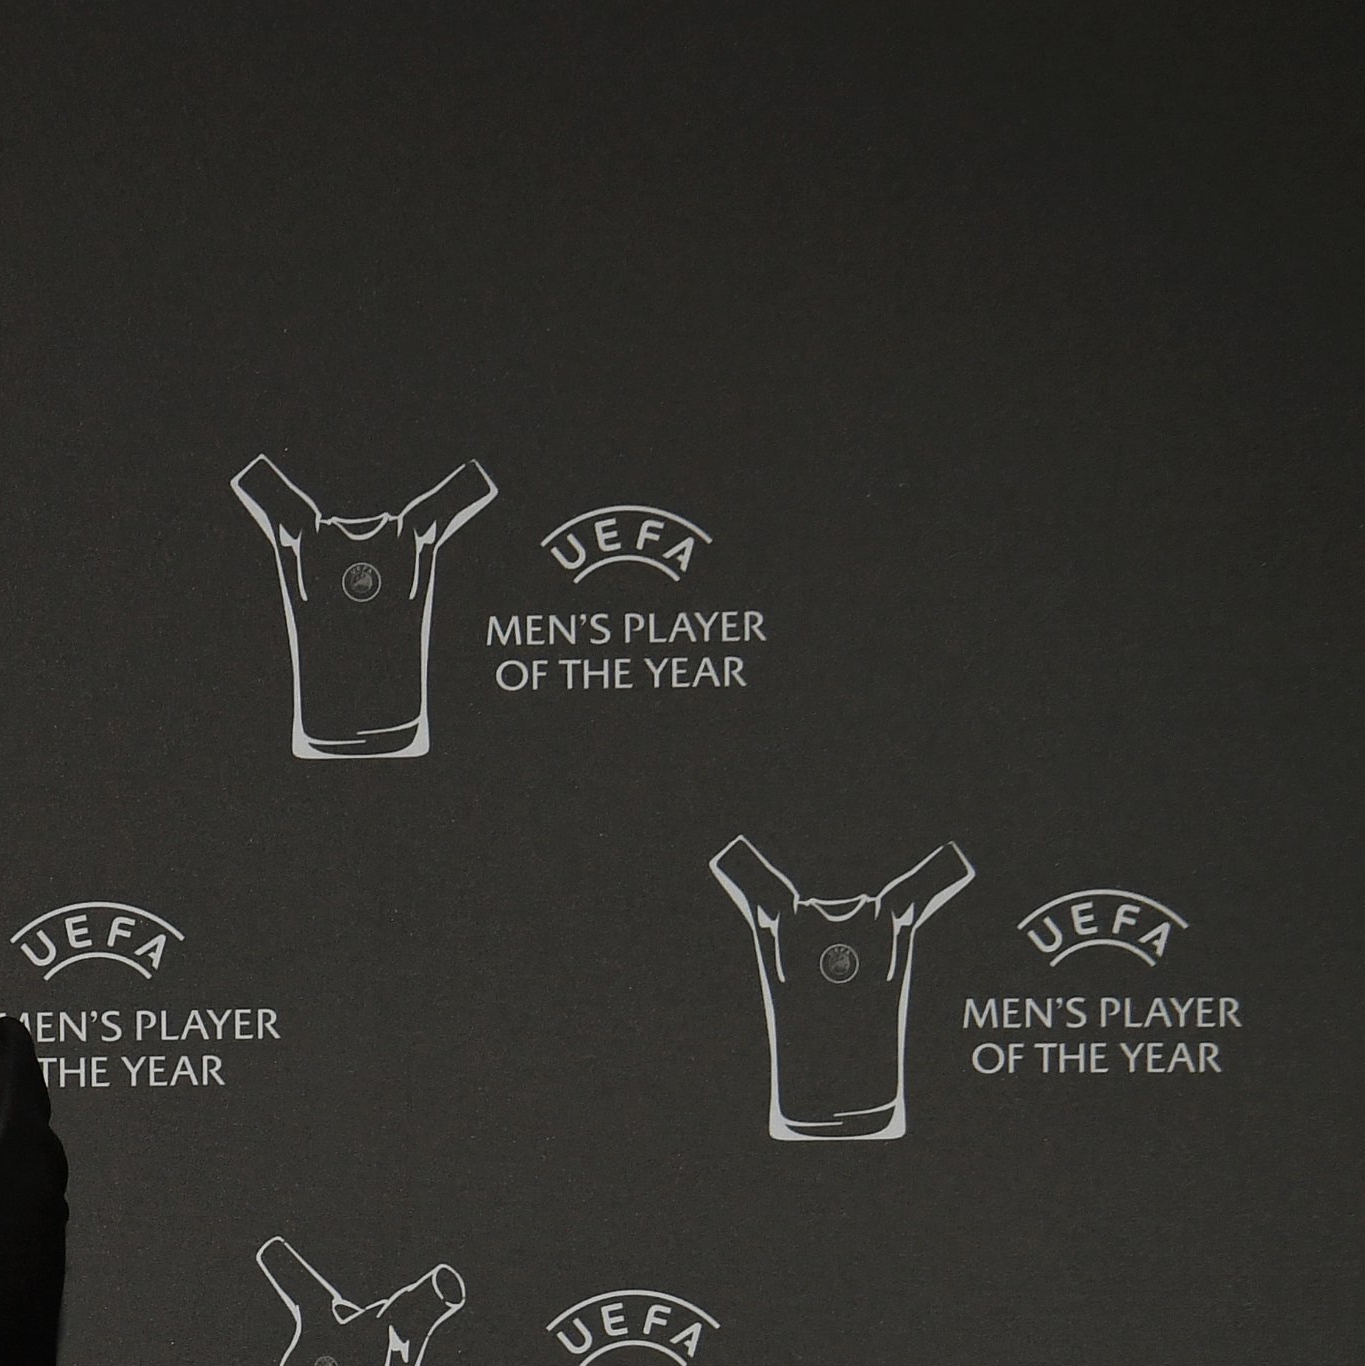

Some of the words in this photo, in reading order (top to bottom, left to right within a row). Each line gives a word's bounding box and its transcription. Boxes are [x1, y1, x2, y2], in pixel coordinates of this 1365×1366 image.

[551, 518, 694, 571] UEFA
[487, 614, 610, 645] MEN'S
[625, 611, 766, 643] PLAYER
[496, 660, 548, 691] OF
[559, 659, 633, 689] THE
[644, 657, 746, 688] YEAR
[21, 915, 167, 970] UEFA
[1028, 902, 1170, 956] UEFA
[136, 1009, 281, 1041] PLAYER
[963, 997, 1086, 1028] MEN'S
[1101, 998, 1241, 1027] PLAYER
[37, 1057, 111, 1088] THE
[121, 1055, 226, 1087] YEAR
[972, 1043, 1024, 1074] OF
[1034, 1043, 1108, 1073] THE
[1120, 1043, 1221, 1072] YEAR
[557, 1303, 702, 1357] UEFA
